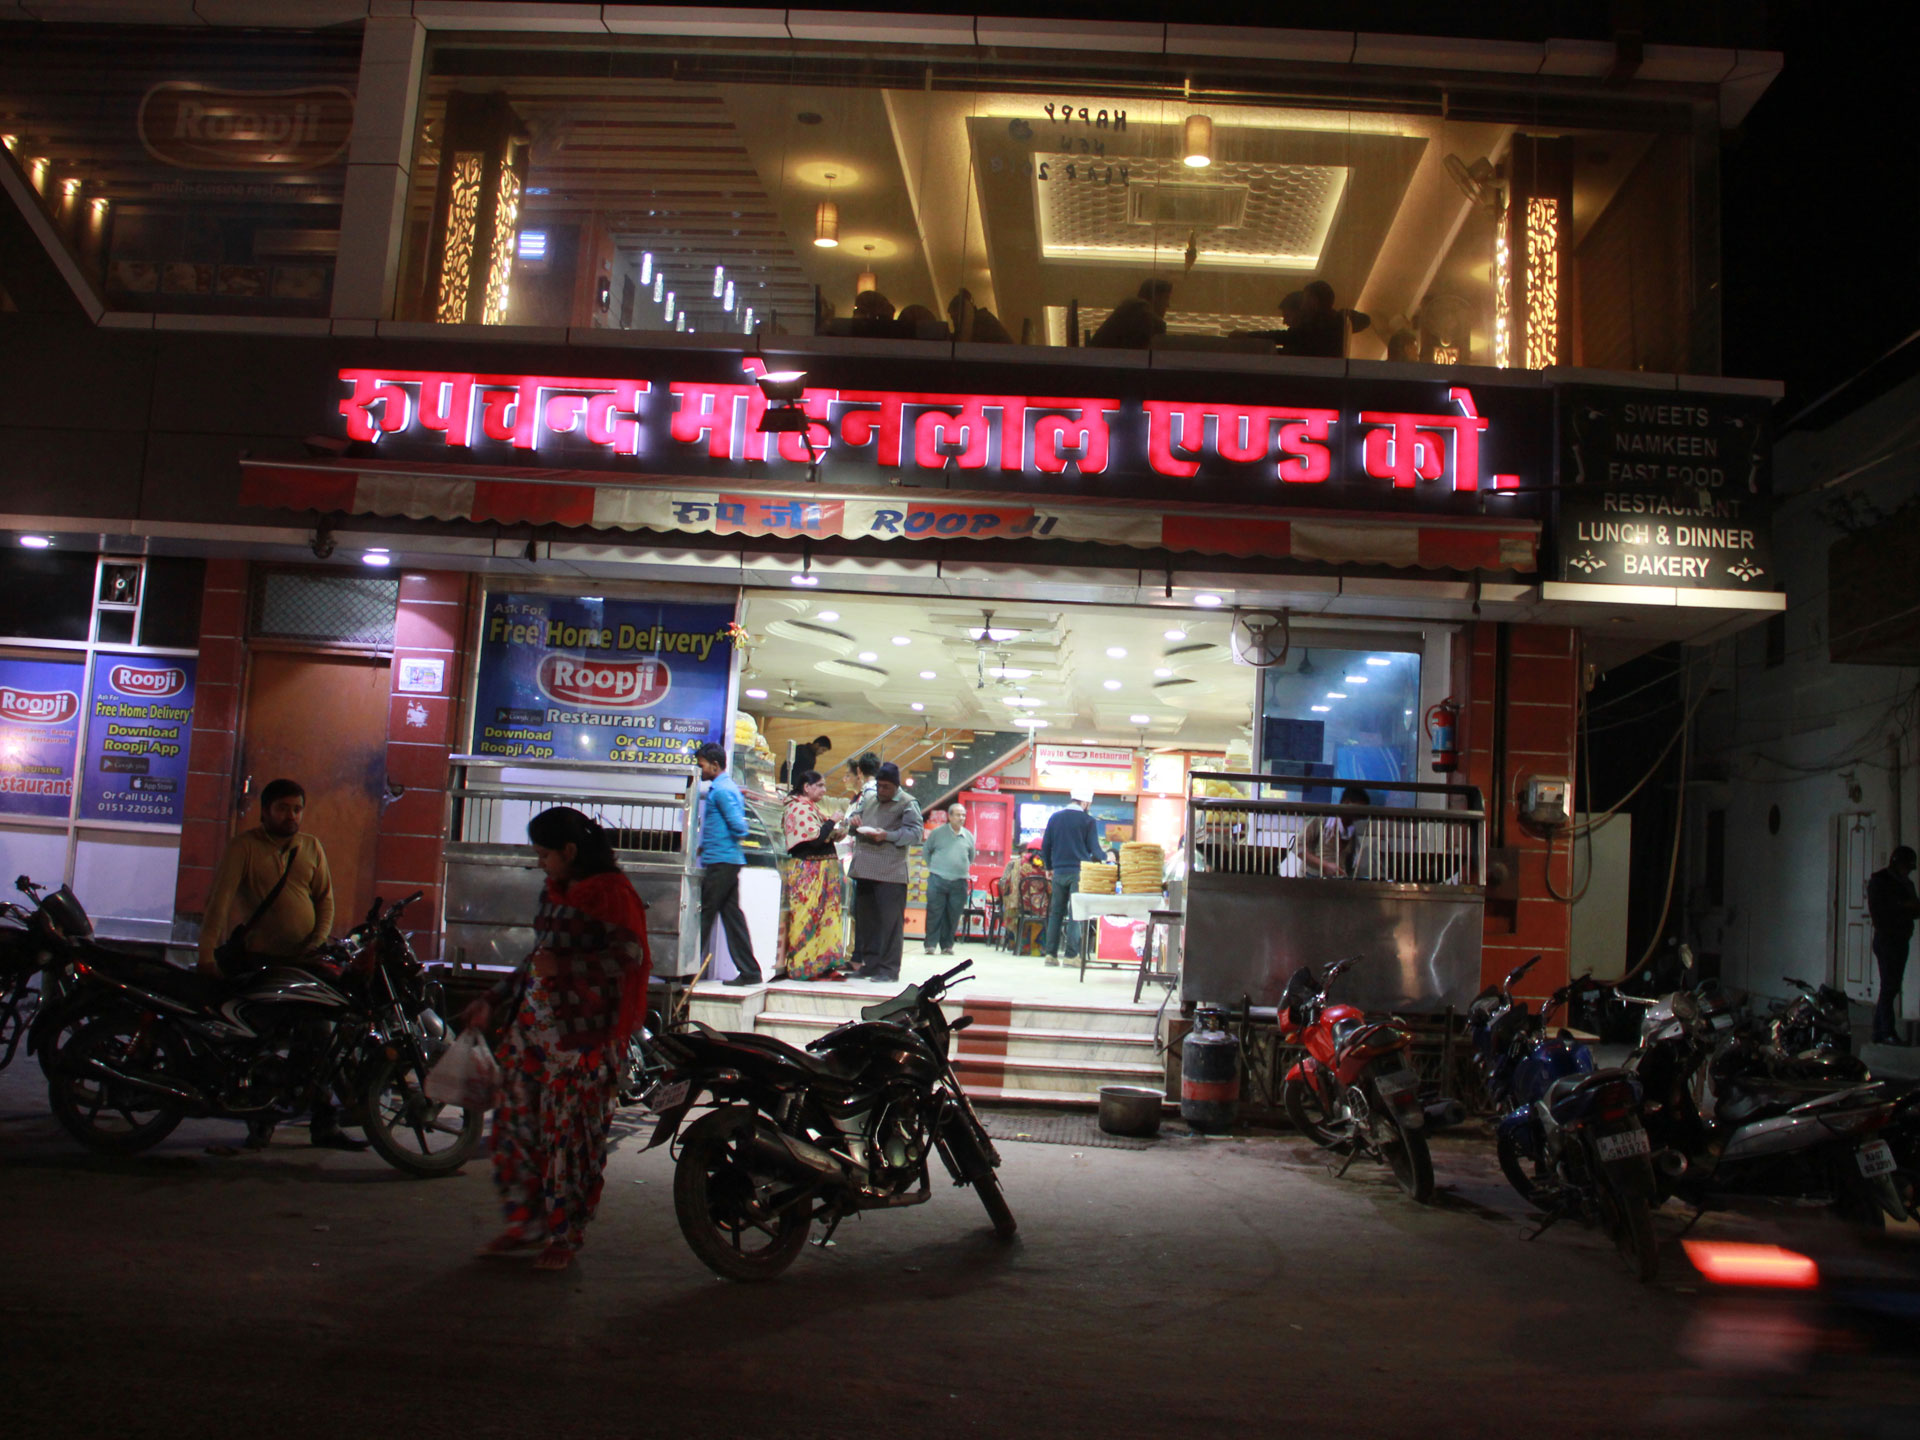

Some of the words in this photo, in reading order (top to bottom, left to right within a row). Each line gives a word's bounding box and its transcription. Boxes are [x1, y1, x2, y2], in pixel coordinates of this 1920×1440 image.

[173, 99, 322, 150] Roopji
[669, 357, 1121, 474] मोहनलाल
[1142, 400, 1339, 483] एण्ड
[1623, 403, 1709, 428] SWEETS
[1615, 433, 1718, 457] NAMKEEN
[1608, 462, 1661, 481] FAST
[1665, 465, 1726, 488] FOOD
[872, 508, 998, 536] ROOP
[1578, 521, 1650, 545] LUNCH
[1655, 525, 1671, 546] &
[1676, 526, 1756, 550] DINNER
[1623, 554, 1711, 578] BAKERY
[493, 602, 519, 615] Ask
[522, 604, 544, 616] For
[488, 617, 540, 645] Free
[546, 620, 613, 650] Home
[119, 668, 177, 692] Roopji
[554, 660, 656, 697] Roopji
[1, 691, 69, 717] Roopji
[95, 702, 117, 717] Free
[118, 703, 148, 718] Home
[546, 709, 656, 729] Restaurant
[107, 723, 178, 739] Download
[484, 726, 552, 742] Download
[104, 739, 149, 755] Roopji
[150, 741, 180, 757] App
[480, 741, 524, 757] Roopji
[524, 743, 553, 759] App
[616, 735, 633, 747] Or
[635, 735, 663, 749] Call
[665, 737, 682, 750] Us
[609, 750, 699, 765] 0151-220563
[1039, 748, 1055, 758] Way
[1056, 749, 1064, 757] to
[1089, 751, 1131, 761] Restaurant
[0, 777, 73, 796] staurant
[103, 791, 116, 800] Or
[140, 792, 153, 802] Us
[98, 802, 174, 815] 0151-2205634
